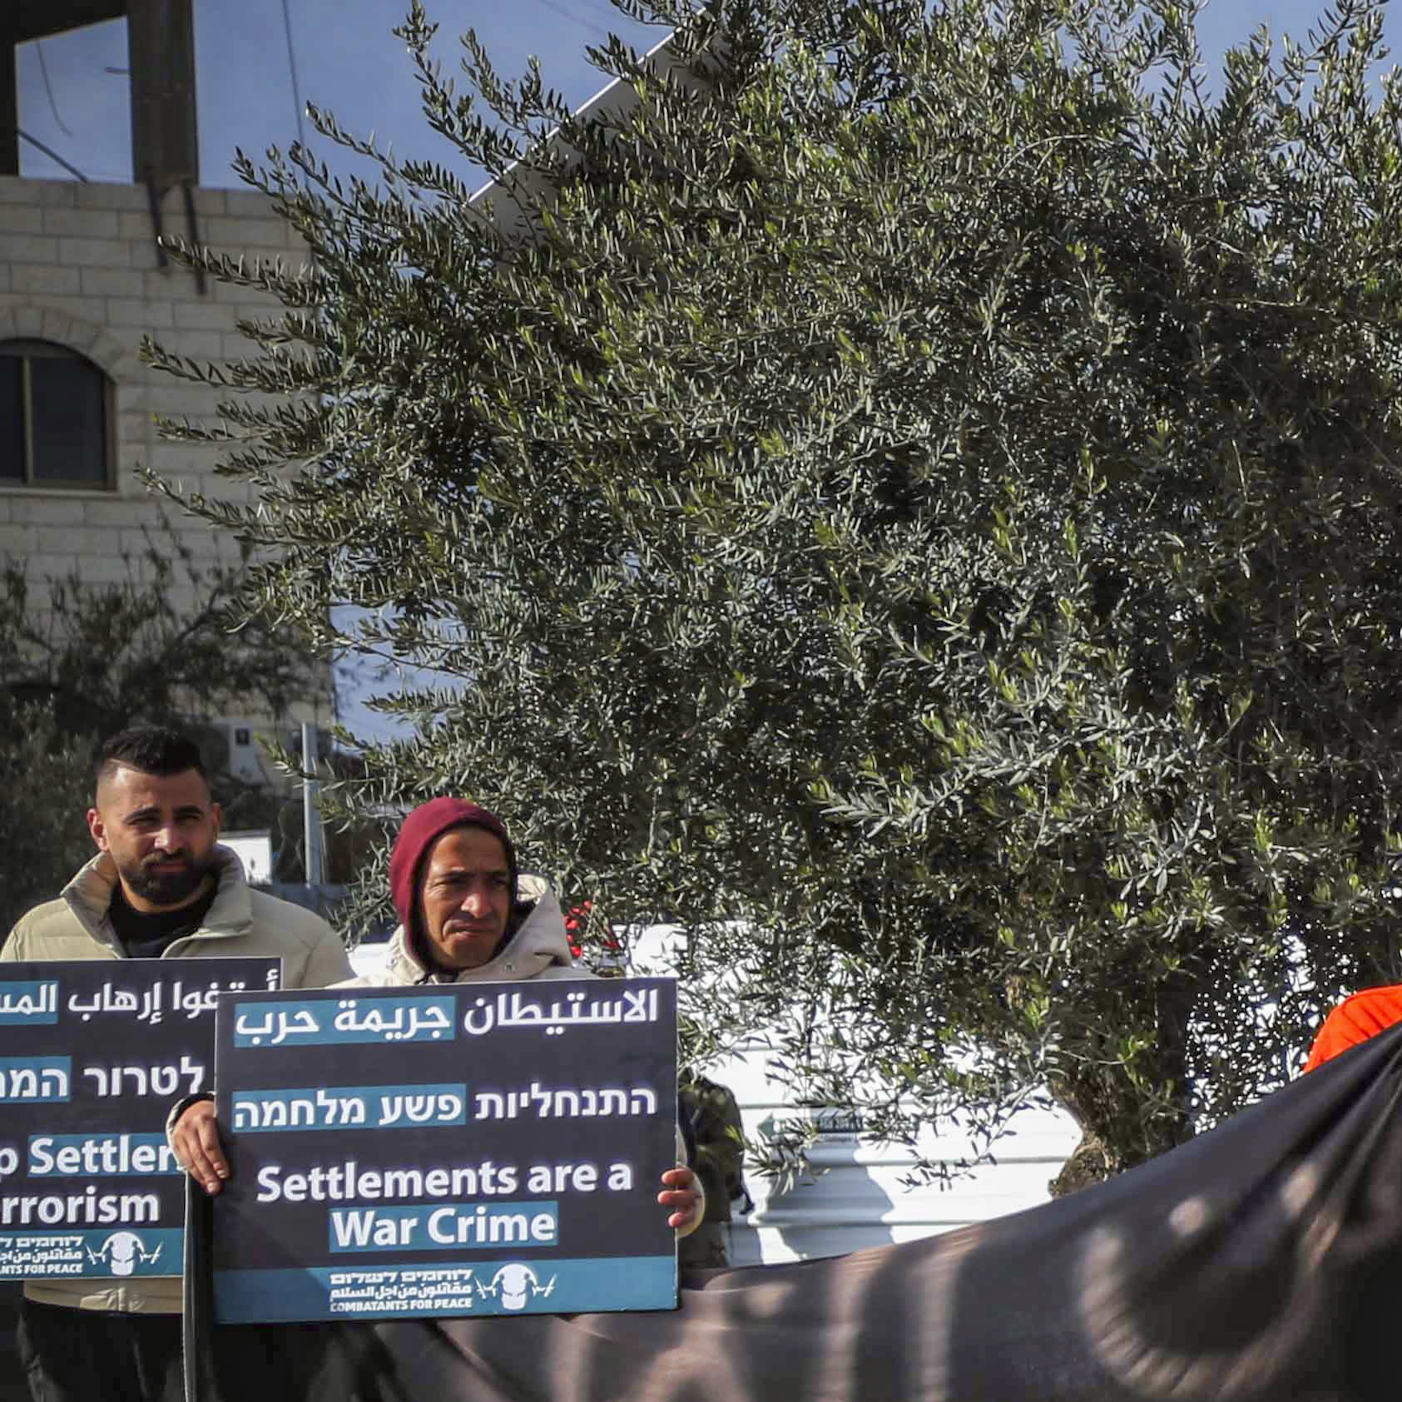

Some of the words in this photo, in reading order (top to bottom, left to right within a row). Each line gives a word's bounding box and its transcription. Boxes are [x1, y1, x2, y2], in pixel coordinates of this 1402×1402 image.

[68, 981, 163, 1025] إرهاب
[333, 998, 451, 1041] جريمة
[464, 988, 659, 1037] الاستيطان
[235, 1010, 320, 1045] حرب
[83, 1055, 206, 1096] לטרור
[234, 1088, 366, 1128] מלחמה
[378, 1091, 462, 1126] פשע
[475, 1081, 657, 1119] התנחליות
[256, 1161, 517, 1202] Settlements
[526, 1166, 599, 1195] are
[608, 1163, 633, 1192] a
[331, 1209, 419, 1249] War
[426, 1204, 557, 1244] Crime
[47, 1263, 84, 1274] PEACE
[330, 1301, 409, 1313] COMBATANTS
[409, 1299, 433, 1310] FOR
[434, 1298, 473, 1309] PEACE
